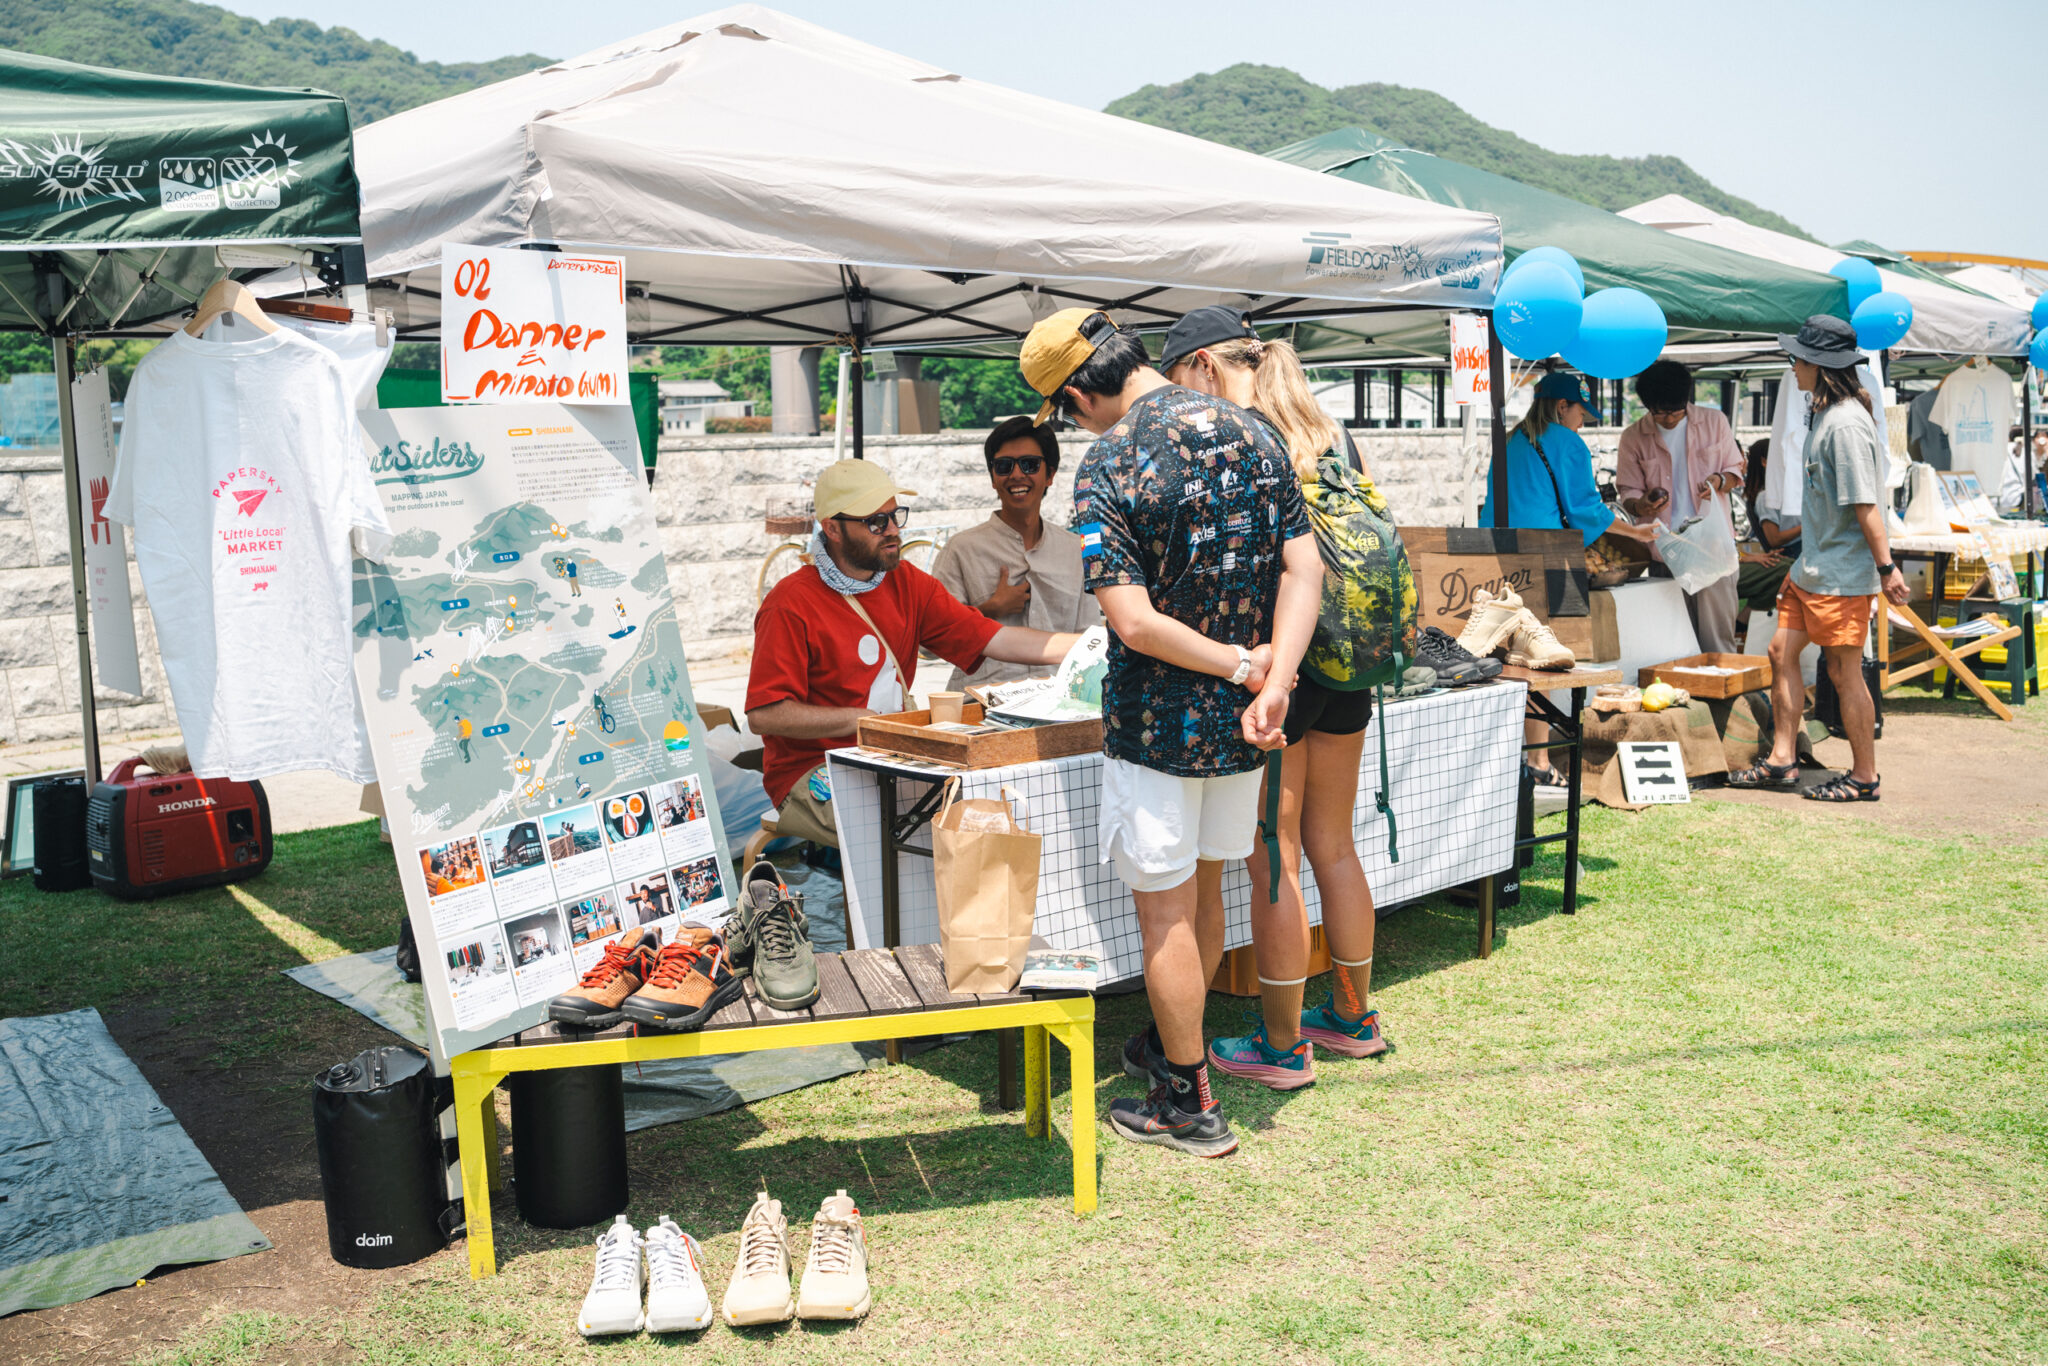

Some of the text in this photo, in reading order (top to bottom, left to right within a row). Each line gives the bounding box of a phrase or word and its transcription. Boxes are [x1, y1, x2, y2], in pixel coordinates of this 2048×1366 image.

[229, 199, 277, 207] PROTECTION
[1326, 247, 1391, 272] FIELDOOR
[454, 257, 492, 301] 02
[463, 308, 607, 353] Danner
[1206, 440, 1240, 455] GIANT
[212, 466, 284, 499] PAPERSKY
[391, 489, 448, 502] MAPPING JAPAN
[407, 502, 433, 511] outdoors
[227, 540, 283, 555] MARKET
[1358, 536, 1380, 547] REI
[239, 564, 277, 576] SHIMANAMI
[158, 796, 217, 814] HONDA
[1231, 1050, 1263, 1063] HOKA
[355, 1232, 393, 1248] daim
